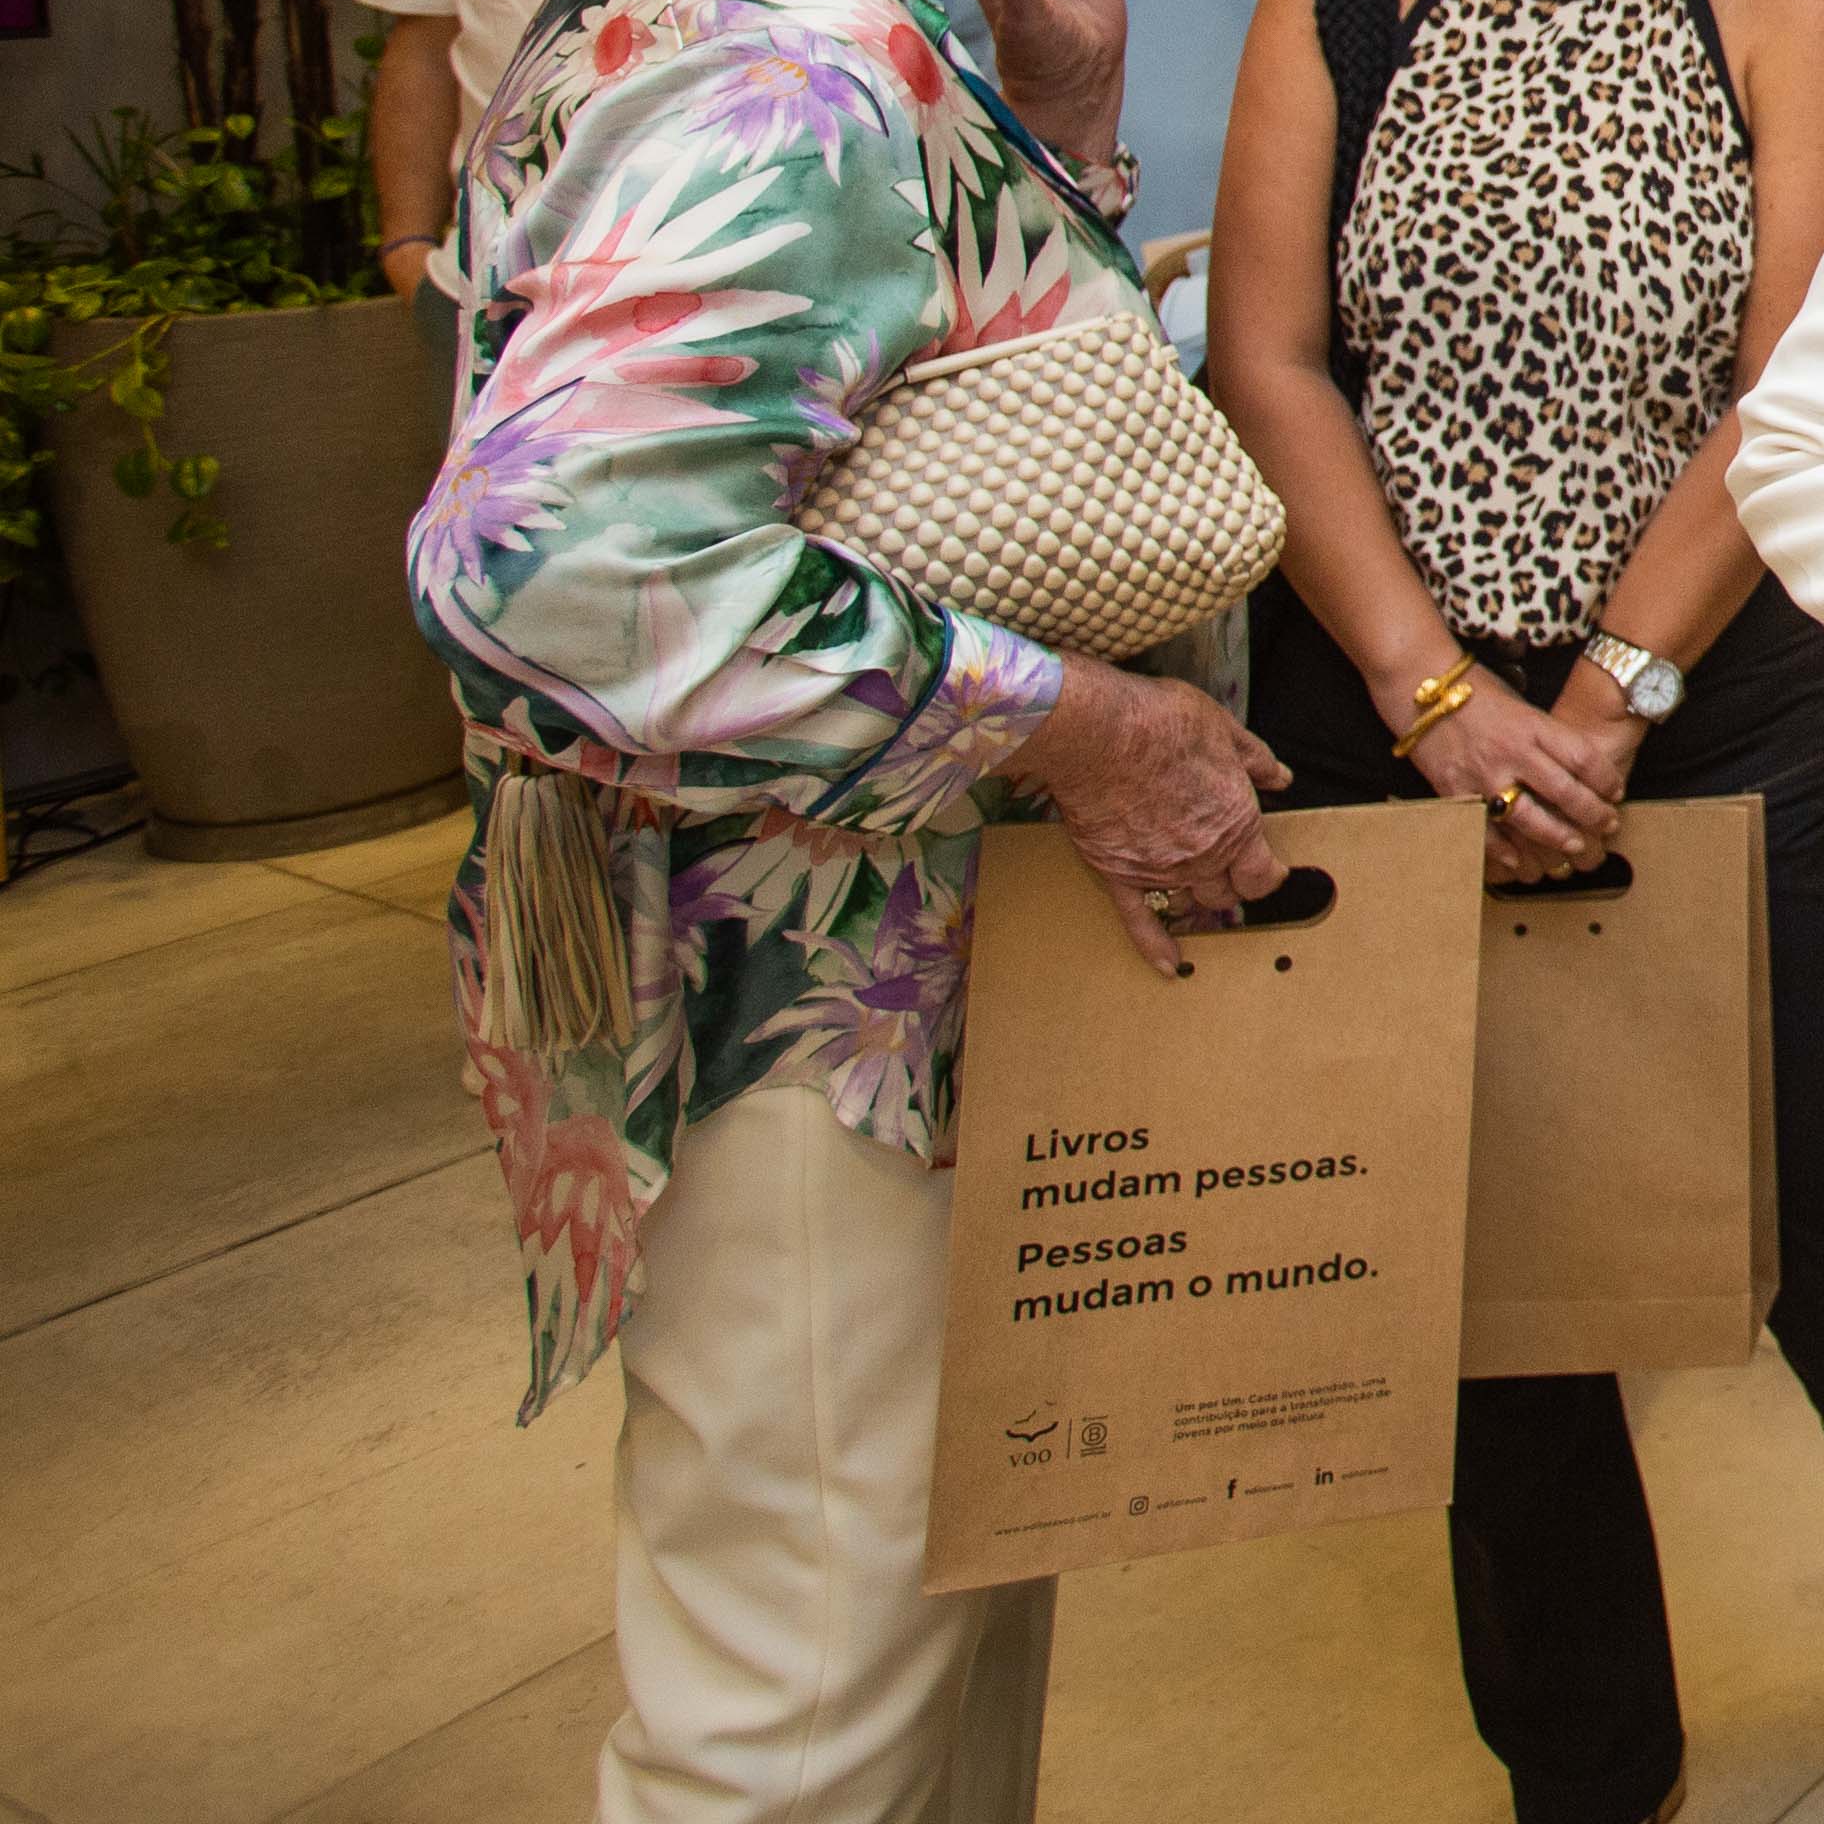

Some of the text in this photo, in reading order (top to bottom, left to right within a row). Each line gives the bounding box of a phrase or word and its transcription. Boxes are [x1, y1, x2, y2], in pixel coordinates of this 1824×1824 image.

[1025, 1127, 1150, 1163] Livros
[1021, 1153, 1369, 1210] mudam pessoas.
[1017, 1229, 1188, 1273] Pessoas
[1013, 1252, 1379, 1322] mudam o mundo.
[1174, 1408, 1249, 1427] contribuição
[1251, 1405, 1277, 1419] para
[1175, 1402, 1196, 1414] Um
[1198, 1399, 1219, 1412] por
[1247, 1392, 1278, 1404] Cada
[1172, 1428, 1211, 1443] jovens
[1214, 1424, 1235, 1436] por
